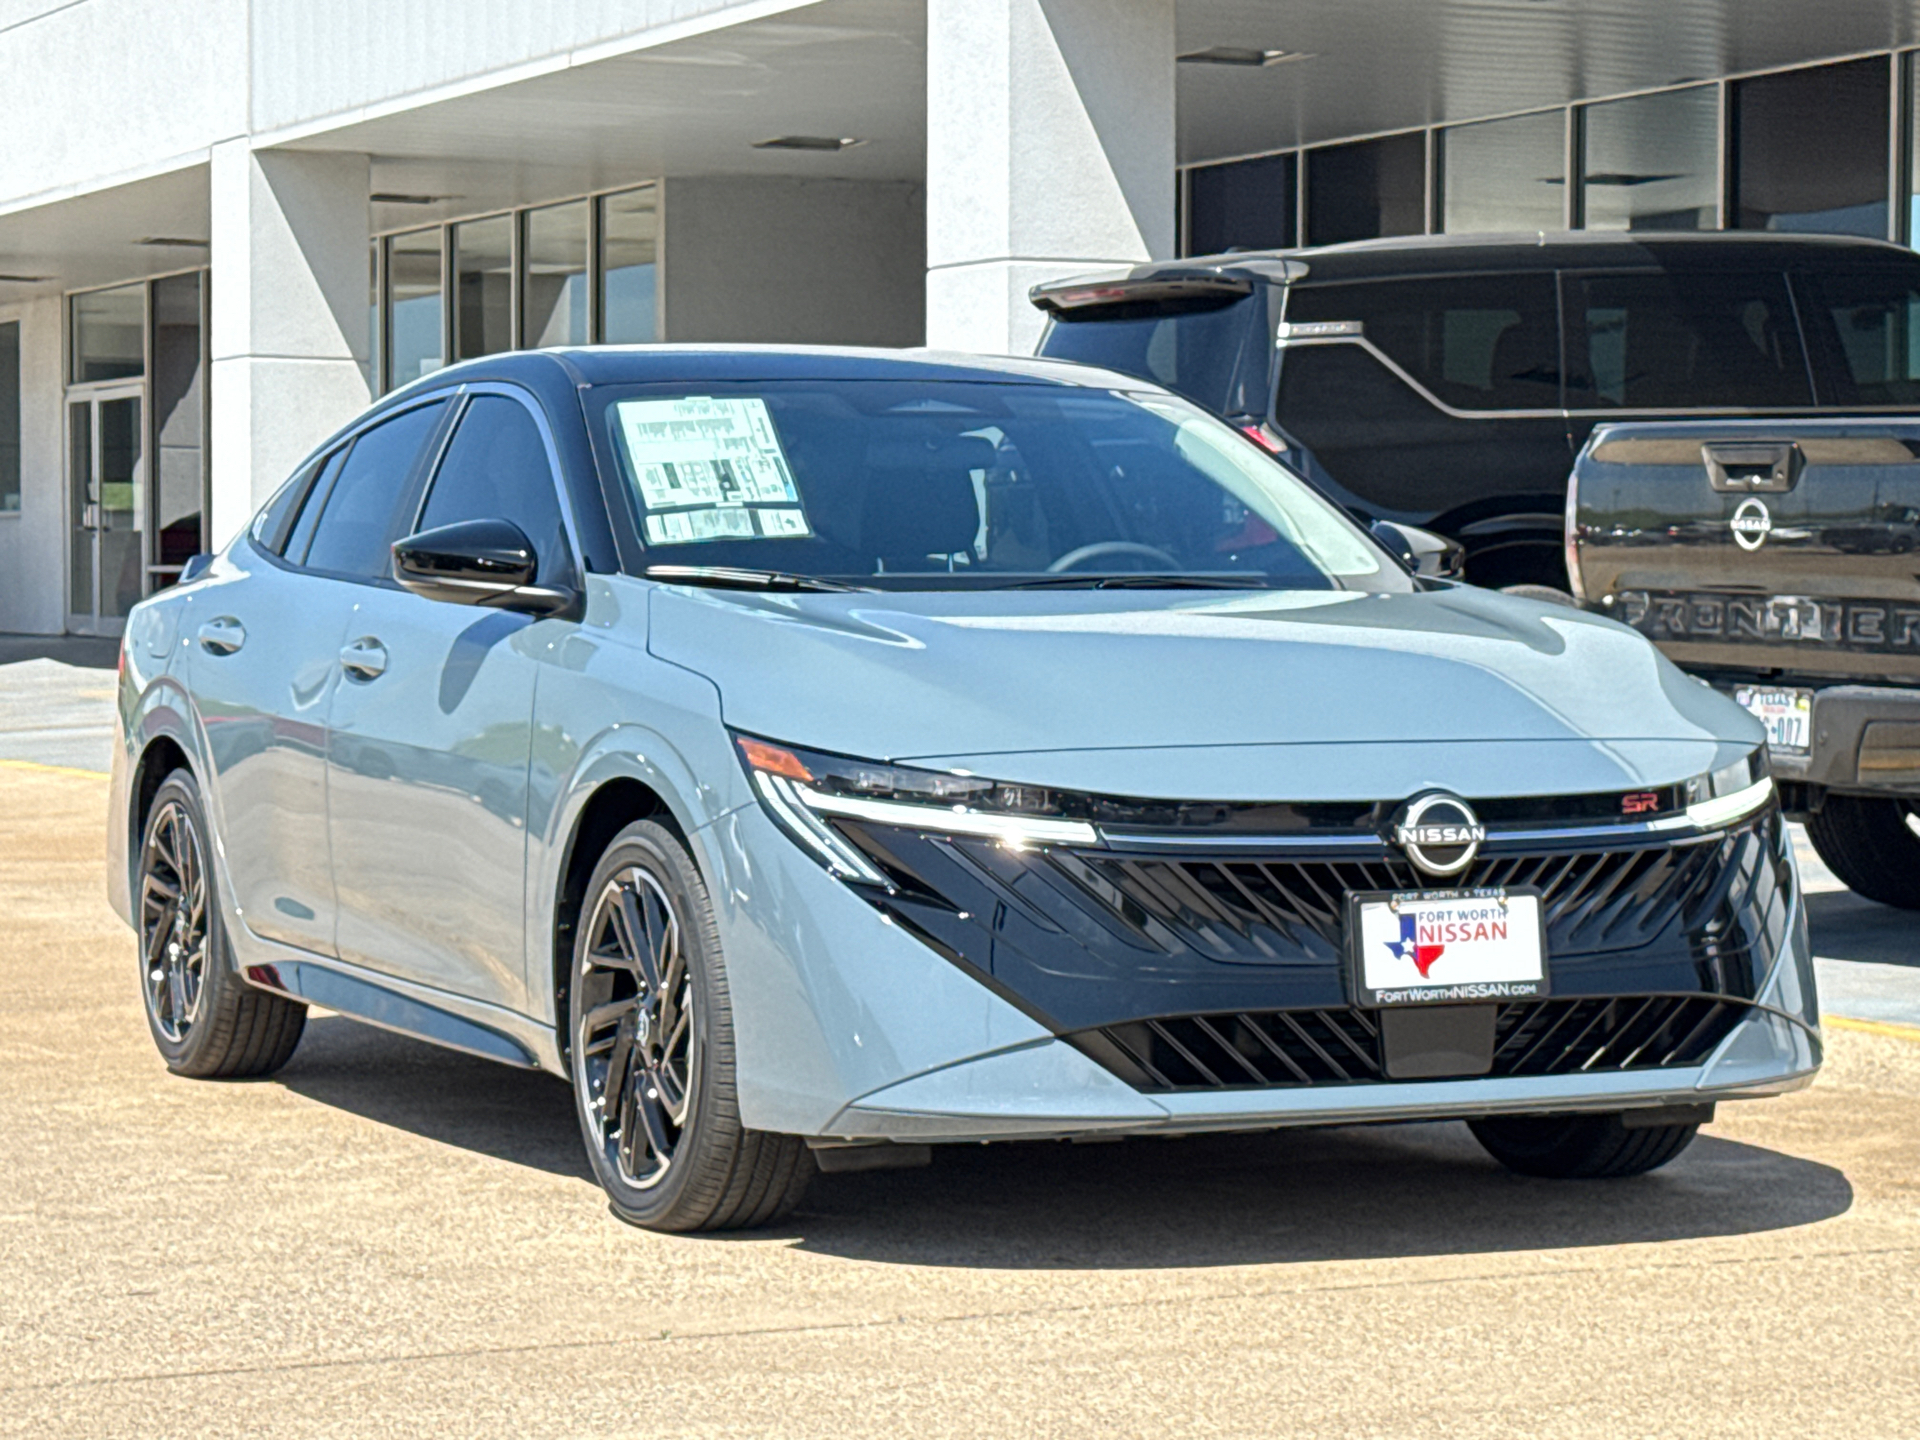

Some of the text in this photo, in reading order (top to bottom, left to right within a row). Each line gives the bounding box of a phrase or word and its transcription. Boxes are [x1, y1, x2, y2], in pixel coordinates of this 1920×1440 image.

[1622, 793, 1658, 813] SR
[1400, 827, 1485, 843] NISSAN
[1423, 890, 1459, 899] WORTH
[1473, 887, 1506, 897] TEXAS
[1419, 908, 1507, 922] FORT WORTH
[1420, 921, 1507, 942] NISSAN
